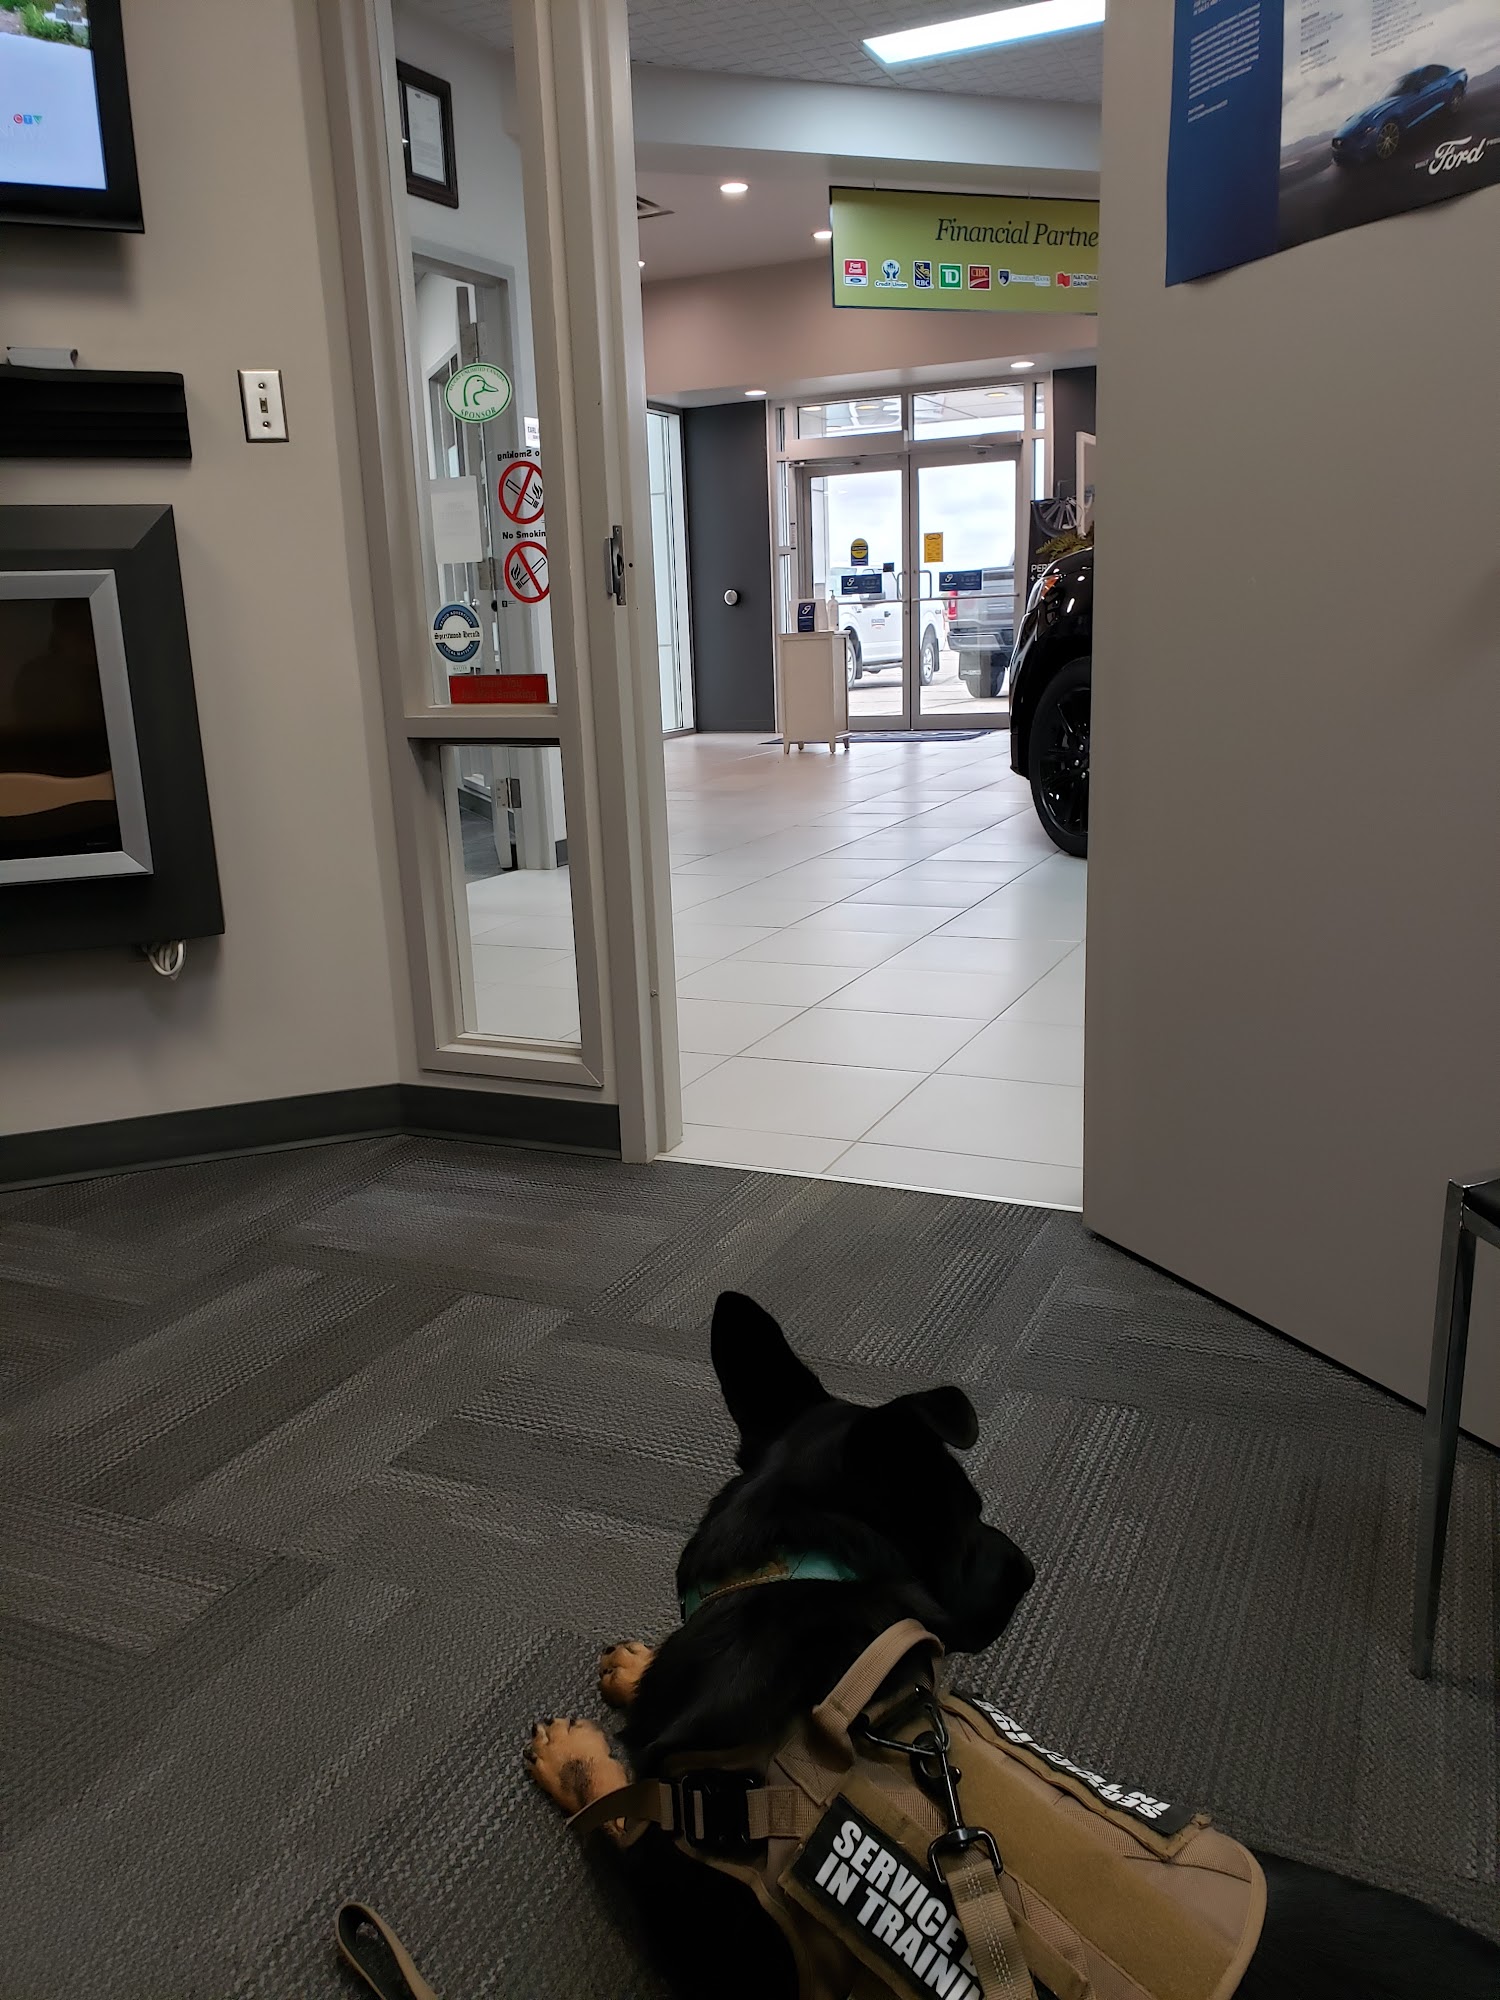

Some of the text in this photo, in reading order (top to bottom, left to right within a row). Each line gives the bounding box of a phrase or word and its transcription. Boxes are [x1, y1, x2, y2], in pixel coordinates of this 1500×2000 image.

[13, 113, 42, 125] CTV
[1428, 135, 1487, 175] Ford
[935, 218, 1099, 247] Financial Partne
[942, 268, 960, 284] TD
[971, 268, 988, 277] CIBC
[915, 279, 930, 287] RBC
[460, 406, 497, 419] SPONSOR
[502, 529, 546, 540] No Smokin
[1031, 563, 1050, 573] PER
[832, 1820, 965, 1955] SERVICE
[814, 1851, 982, 2000] IN TRAINI
